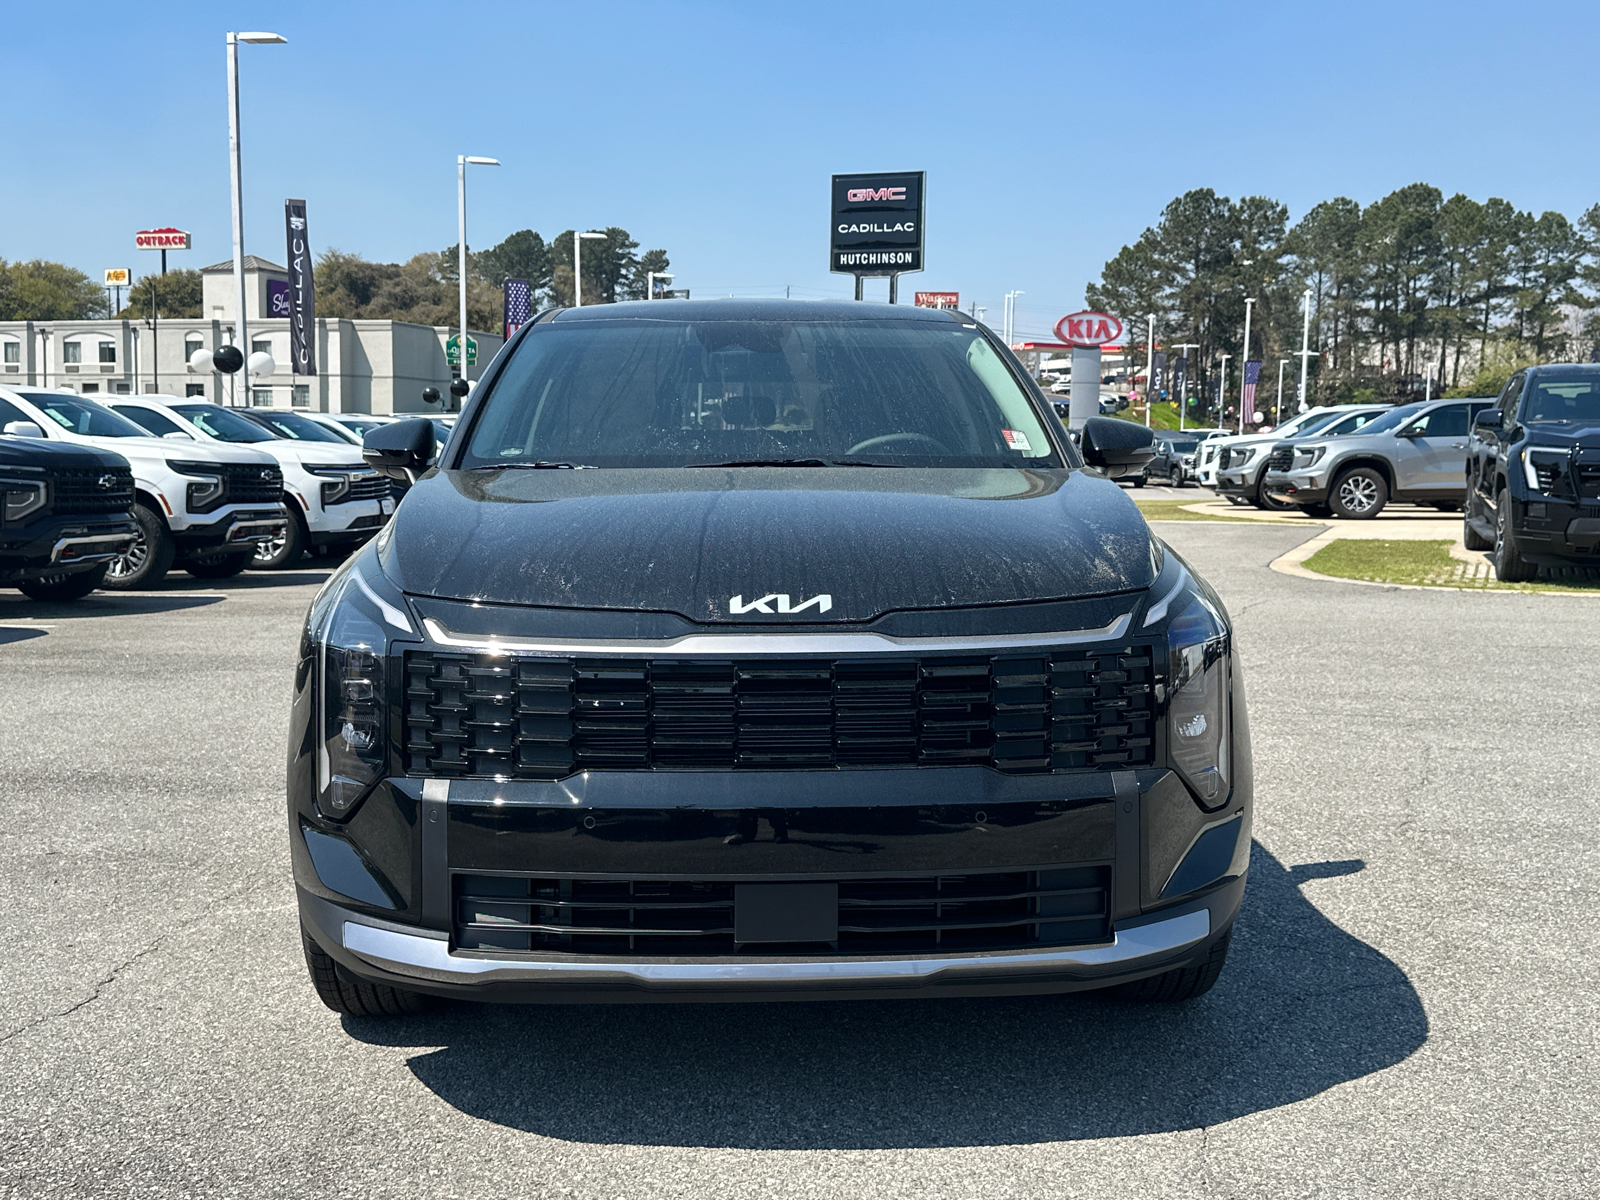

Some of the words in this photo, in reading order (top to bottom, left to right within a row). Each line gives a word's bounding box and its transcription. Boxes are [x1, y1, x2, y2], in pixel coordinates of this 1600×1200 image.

[847, 187, 907, 202] GMC
[838, 222, 915, 233] CADILLAC
[136, 235, 186, 246] OUTBACK
[840, 252, 912, 265] HUTCHINSON
[292, 238, 309, 364] CADILLAC
[1067, 319, 1112, 339] KIA
[729, 594, 833, 614] KIA
